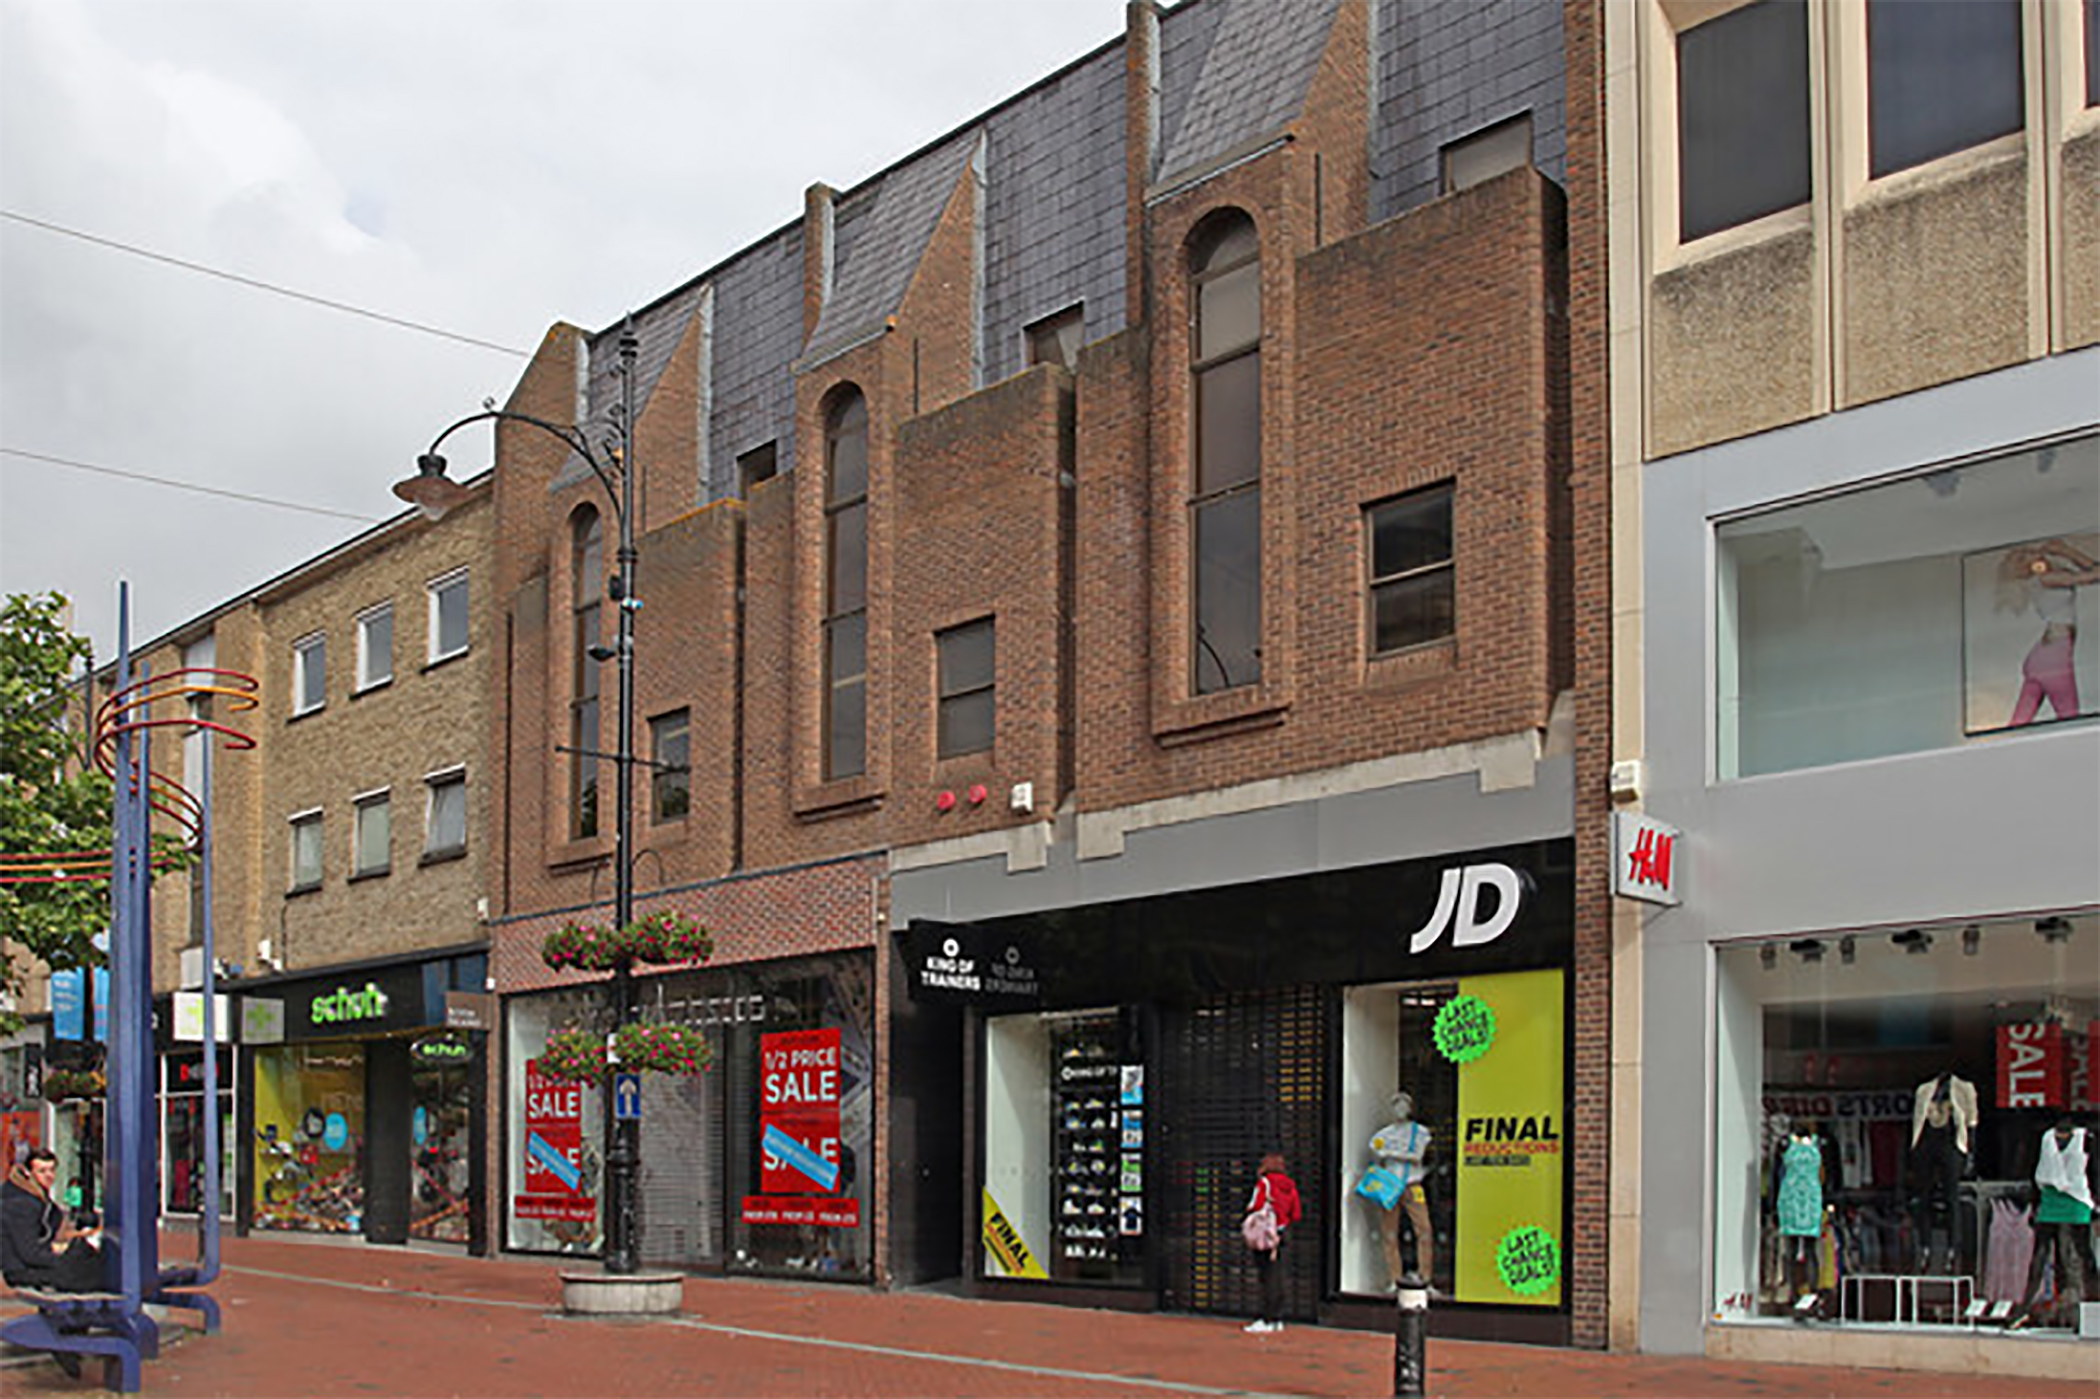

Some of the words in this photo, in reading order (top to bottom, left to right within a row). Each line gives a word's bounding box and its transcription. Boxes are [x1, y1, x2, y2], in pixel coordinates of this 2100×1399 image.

[1628, 826, 1673, 891] H&M
[1409, 862, 1520, 954] JD
[926, 956, 957, 973] KING
[958, 959, 974, 974] OF
[920, 970, 980, 991] TRAINERS
[311, 982, 389, 1024] schuh
[422, 1043, 467, 1056] schuh
[790, 1046, 837, 1068] PRICE
[2008, 1023, 2046, 1109] SALE
[764, 1070, 838, 1104] SALE
[528, 1091, 580, 1119] SALE
[1465, 1116, 1560, 1142] FINAL
[990, 1212, 1028, 1268] FINAL
[1507, 1230, 1540, 1253] LAST
